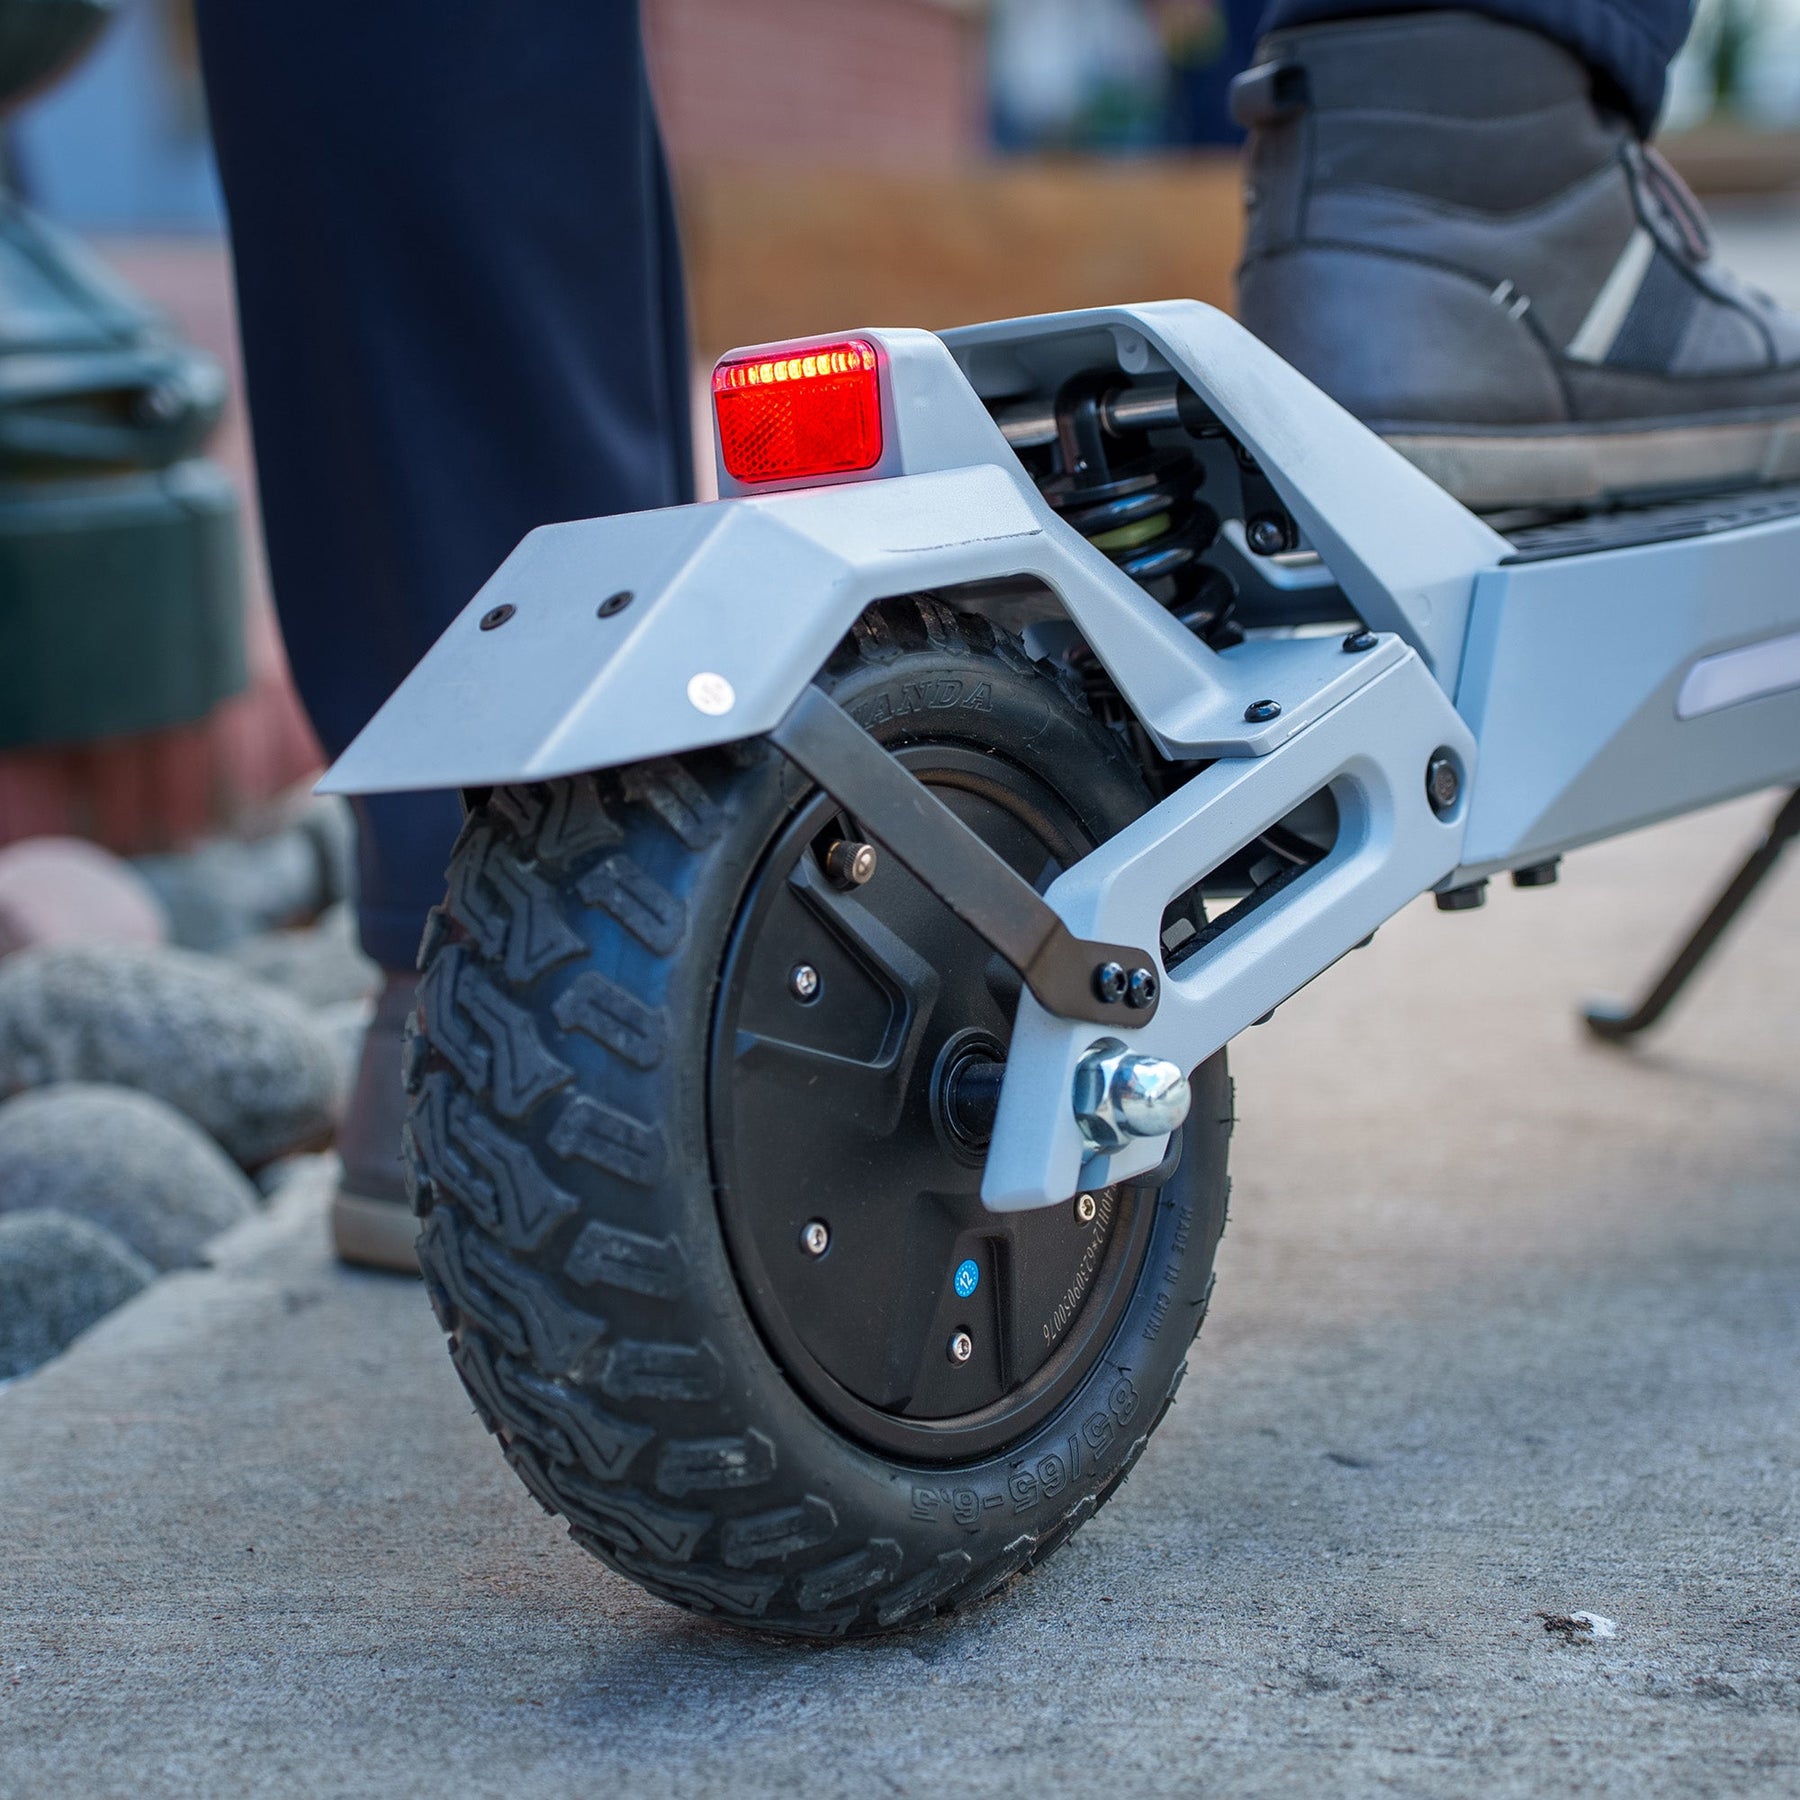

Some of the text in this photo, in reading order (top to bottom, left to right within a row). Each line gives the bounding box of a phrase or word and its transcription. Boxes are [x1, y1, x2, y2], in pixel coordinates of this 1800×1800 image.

[961, 1270, 973, 1290] 12
[1142, 1205, 1193, 1341] MADE IN CHINA
